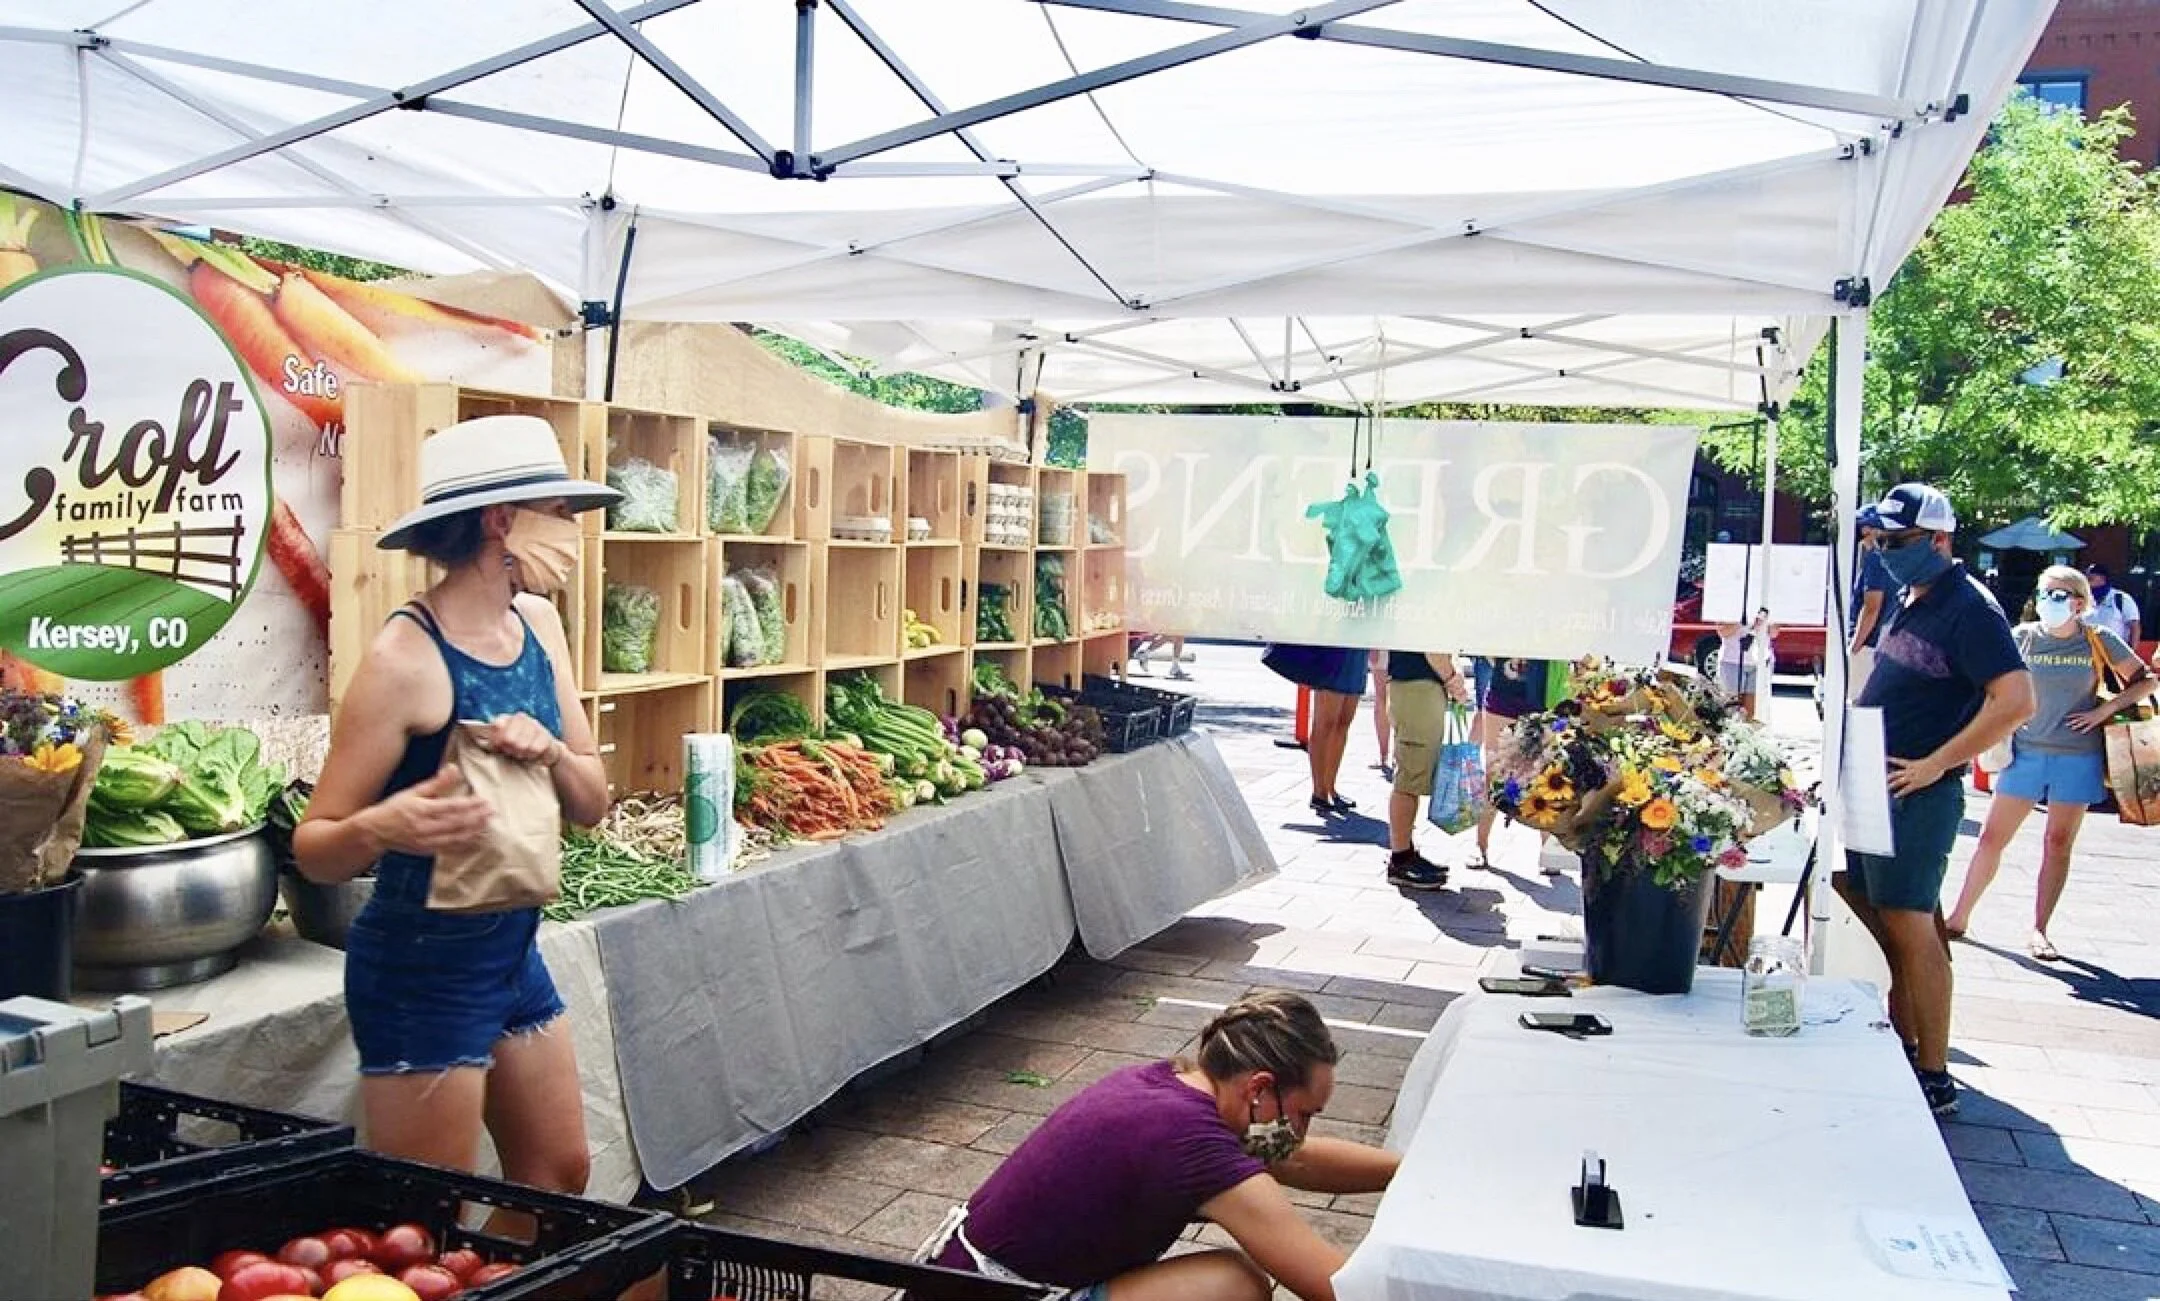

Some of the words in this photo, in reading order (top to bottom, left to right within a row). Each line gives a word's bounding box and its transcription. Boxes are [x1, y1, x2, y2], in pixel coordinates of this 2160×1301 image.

[283, 354, 337, 399] Safe
[0, 328, 243, 540] Croft
[55, 493, 151, 524] family
[176, 487, 243, 512] farm
[28, 616, 140, 655] Kersey,
[148, 616, 188, 649] CO
